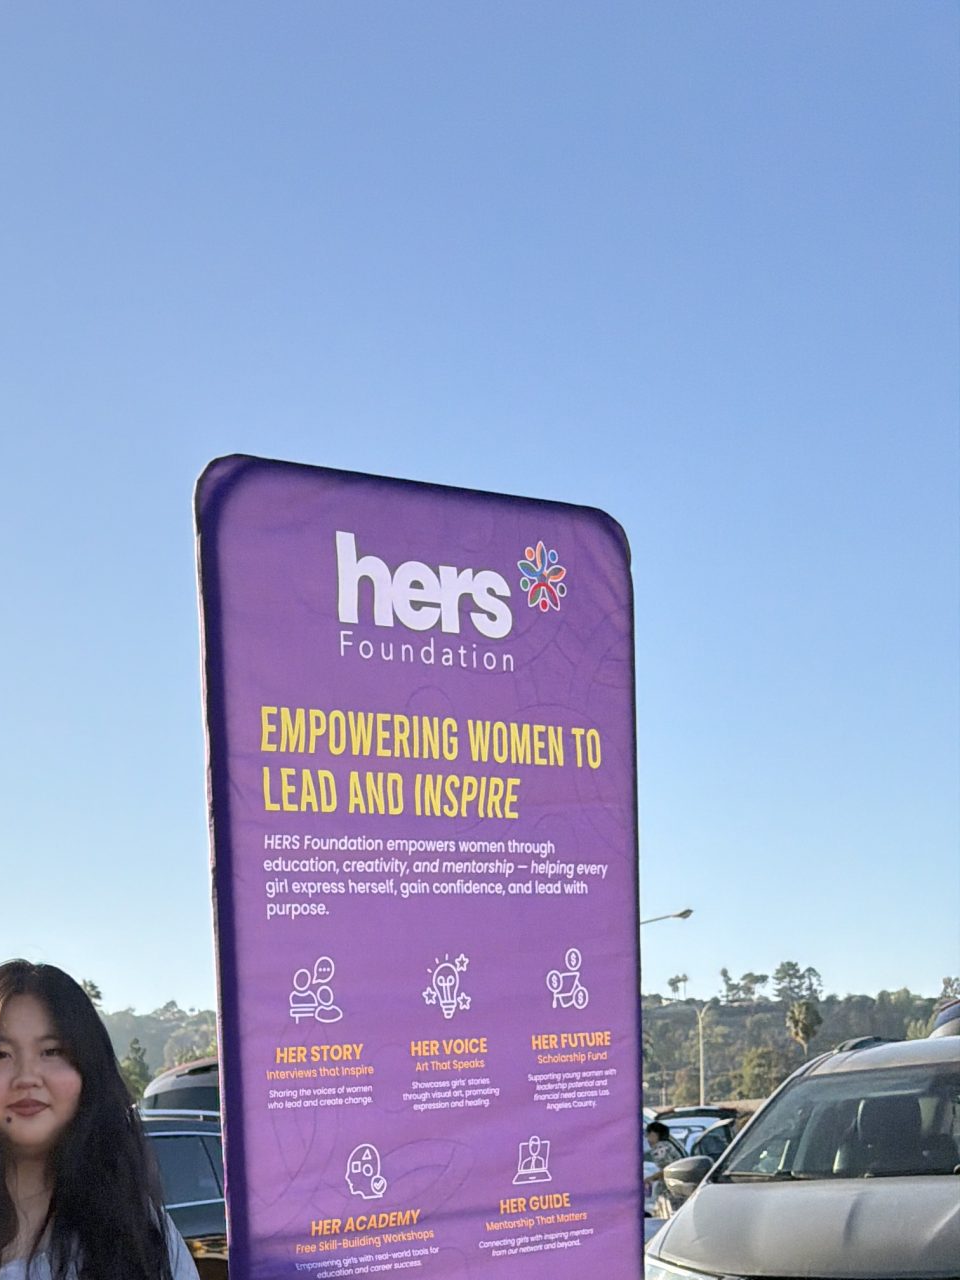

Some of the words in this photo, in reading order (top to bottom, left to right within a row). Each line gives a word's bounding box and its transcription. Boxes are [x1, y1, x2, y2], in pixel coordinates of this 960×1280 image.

[336, 531, 512, 639] hers
[340, 631, 514, 672] Foundation
[261, 706, 458, 761] EMPOWERING
[468, 720, 563, 766] WOMEN
[571, 728, 601, 769] TO
[263, 767, 337, 813] LEAD
[349, 771, 404, 815] AND
[414, 774, 521, 819] INSPIRE
[264, 835, 300, 850] HERS
[304, 835, 383, 851] Foundation
[386, 839, 456, 856] empowers
[458, 841, 505, 852] women
[508, 839, 555, 858] through
[263, 857, 339, 875] education,
[343, 858, 410, 877] creativity,
[412, 858, 440, 873] and
[442, 859, 514, 877] mentorship
[531, 860, 574, 878] helping
[577, 864, 608, 879] every
[266, 878, 289, 898] girl
[292, 881, 345, 898] express
[348, 879, 398, 896] herself,
[400, 879, 429, 898] gain
[432, 880, 506, 896] confidence,
[508, 880, 532, 894] and
[535, 880, 561, 894] lead
[564, 880, 588, 894] with
[267, 903, 329, 920] purpose.
[410, 1040, 439, 1056] HER
[442, 1037, 487, 1055] VOICE
[532, 1034, 558, 1050] HER
[560, 1031, 611, 1048] FUTURE
[275, 1047, 307, 1064] HER
[310, 1044, 363, 1061] STORY
[537, 1053, 586, 1064] Scholarship
[588, 1051, 607, 1061] Fund
[266, 1068, 317, 1080] Interviews
[319, 1066, 340, 1077] that
[342, 1065, 374, 1078] Inspire
[416, 1062, 429, 1071] Art
[431, 1061, 451, 1070] That
[452, 1059, 485, 1072] Speaks
[412, 1080, 450, 1089] Showcases
[528, 1072, 561, 1082] Supporting
[562, 1072, 580, 1080] young
[269, 1089, 298, 1099] Sharing
[299, 1088, 311, 1096] the
[312, 1087, 336, 1095] voices
[337, 1086, 345, 1094] of
[346, 1085, 373, 1093] women
[402, 1092, 430, 1101] through
[431, 1090, 452, 1098] visual
[465, 1088, 500, 1098] promoting
[267, 1100, 283, 1109] who
[285, 1100, 302, 1108] lead
[303, 1099, 318, 1107] and
[319, 1097, 343, 1106] create
[344, 1096, 373, 1105] change.
[413, 1101, 449, 1112] expression
[499, 1197, 526, 1215] HER
[529, 1193, 571, 1211] GUIDE
[311, 1218, 342, 1236] HER
[344, 1209, 420, 1232] ACADEMY
[486, 1217, 535, 1231] Mentorship
[536, 1215, 555, 1225] That
[556, 1212, 588, 1223] Matters
[296, 1243, 317, 1254] Free
[319, 1235, 381, 1252] Skill-Building
[383, 1230, 434, 1243] Workshops
[479, 1238, 515, 1249] Connecting
[516, 1236, 529, 1246] girls
[530, 1234, 543, 1242] with
[295, 1258, 342, 1271] Empowering
[342, 1256, 358, 1266] girls
[359, 1254, 374, 1262] with
[375, 1249, 411, 1261] real-world
[412, 1248, 429, 1256] tools
[430, 1246, 440, 1254] for
[317, 1268, 353, 1279] education
[355, 1265, 368, 1273] and
[370, 1264, 392, 1272] career
